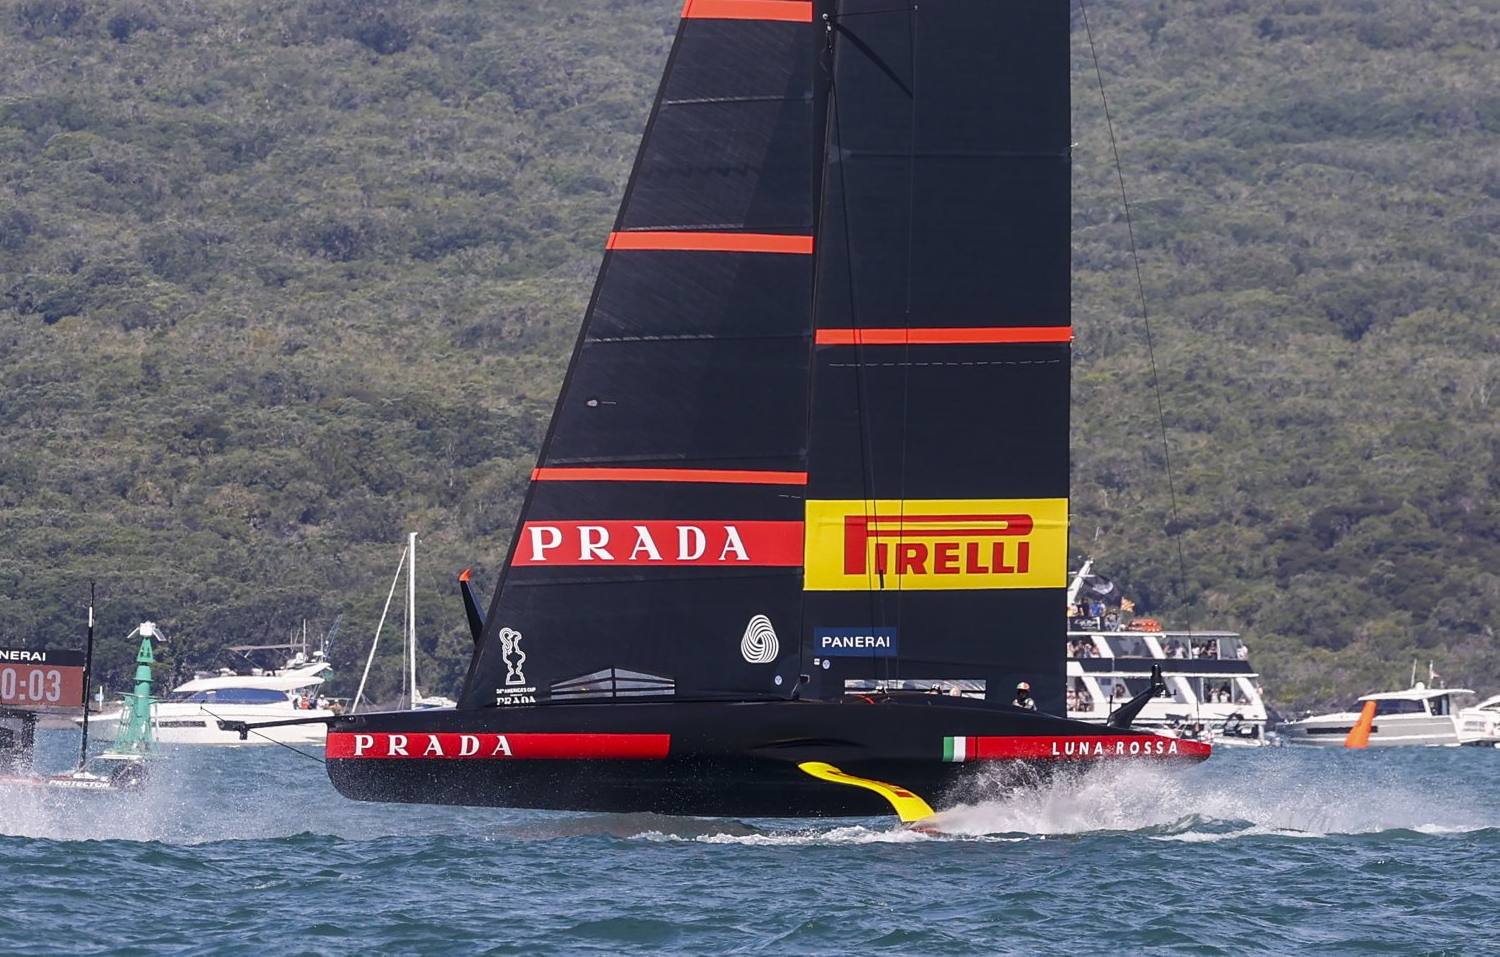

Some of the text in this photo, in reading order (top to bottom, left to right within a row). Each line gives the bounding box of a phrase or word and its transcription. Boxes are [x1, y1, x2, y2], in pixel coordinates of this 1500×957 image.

[528, 525, 751, 561] PRADA
[844, 514, 1033, 575] PIRELLI
[821, 636, 891, 648] PANERAI
[354, 734, 513, 756] PRADA
[1052, 740, 1179, 755] LUNA ROSSA
[49, 780, 111, 788] PROTECTOR
